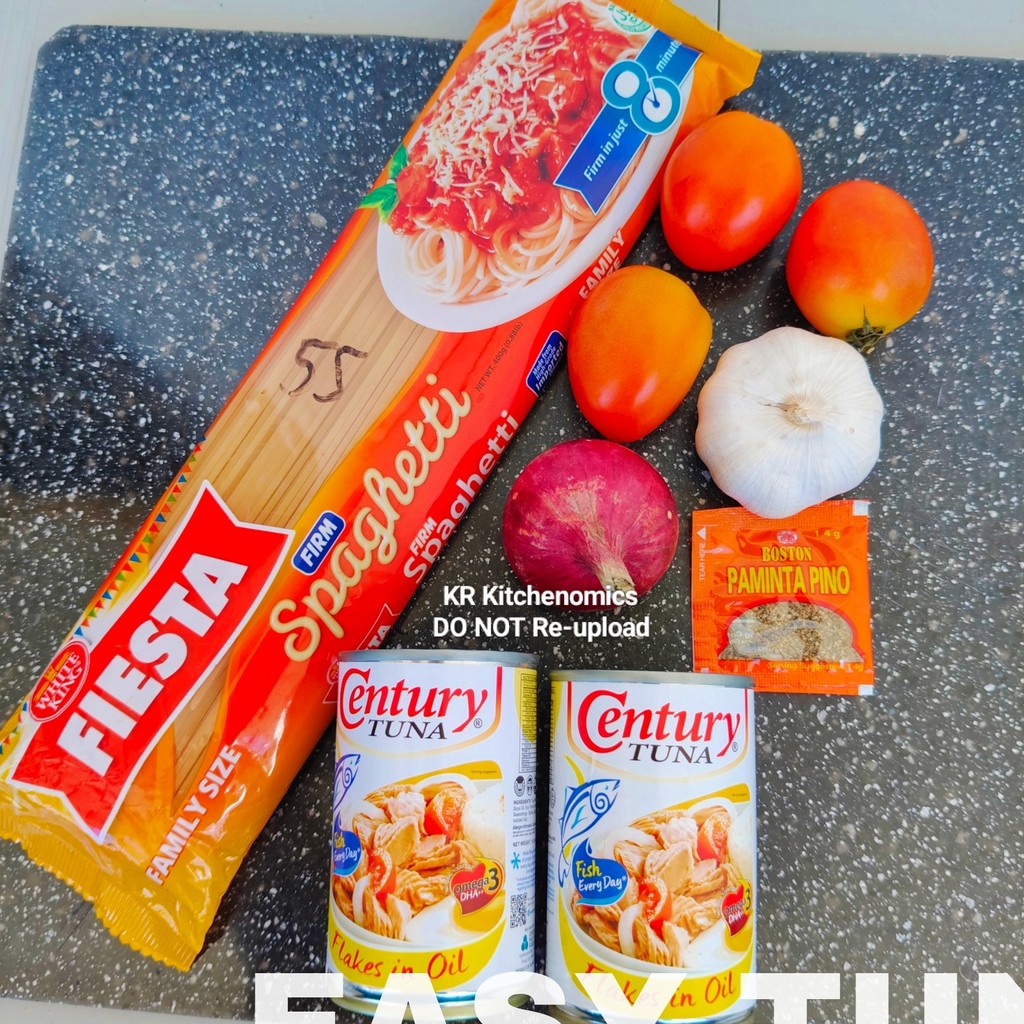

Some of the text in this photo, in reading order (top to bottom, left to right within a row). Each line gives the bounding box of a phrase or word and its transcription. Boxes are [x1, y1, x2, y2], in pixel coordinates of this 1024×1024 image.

[583, 153, 606, 182] Firm
[600, 141, 614, 156] in
[608, 118, 629, 146] just
[578, 228, 625, 300] FAMILY
[475, 321, 524, 392] NET WT. 400g (0.88lb)
[533, 343, 552, 377] Made from
[535, 341, 564, 391] Imported
[269, 372, 472, 662] Spaghetti
[403, 409, 519, 585] Spaghetti
[300, 517, 338, 569] FIRM
[409, 516, 438, 557] FIRM
[762, 546, 812, 562] BOSTON
[727, 565, 851, 595] PAMINTA PINO
[35, 651, 80, 710] WHITE
[47, 660, 83, 712] KING
[56, 552, 249, 778] FIESTA
[339, 667, 489, 734] Century
[577, 689, 742, 758] Century
[368, 719, 447, 741] TUNA
[629, 742, 713, 765] TUNA
[145, 743, 243, 886] FAMILY SIZE
[488, 867, 500, 891] 3
[576, 859, 603, 879] Fish
[578, 878, 603, 892] Every
[745, 889, 751, 911] 3
[332, 931, 383, 977] Flakes
[427, 948, 469, 980] Oil
[669, 988, 697, 1008] in
[704, 970, 737, 1004] Oil
